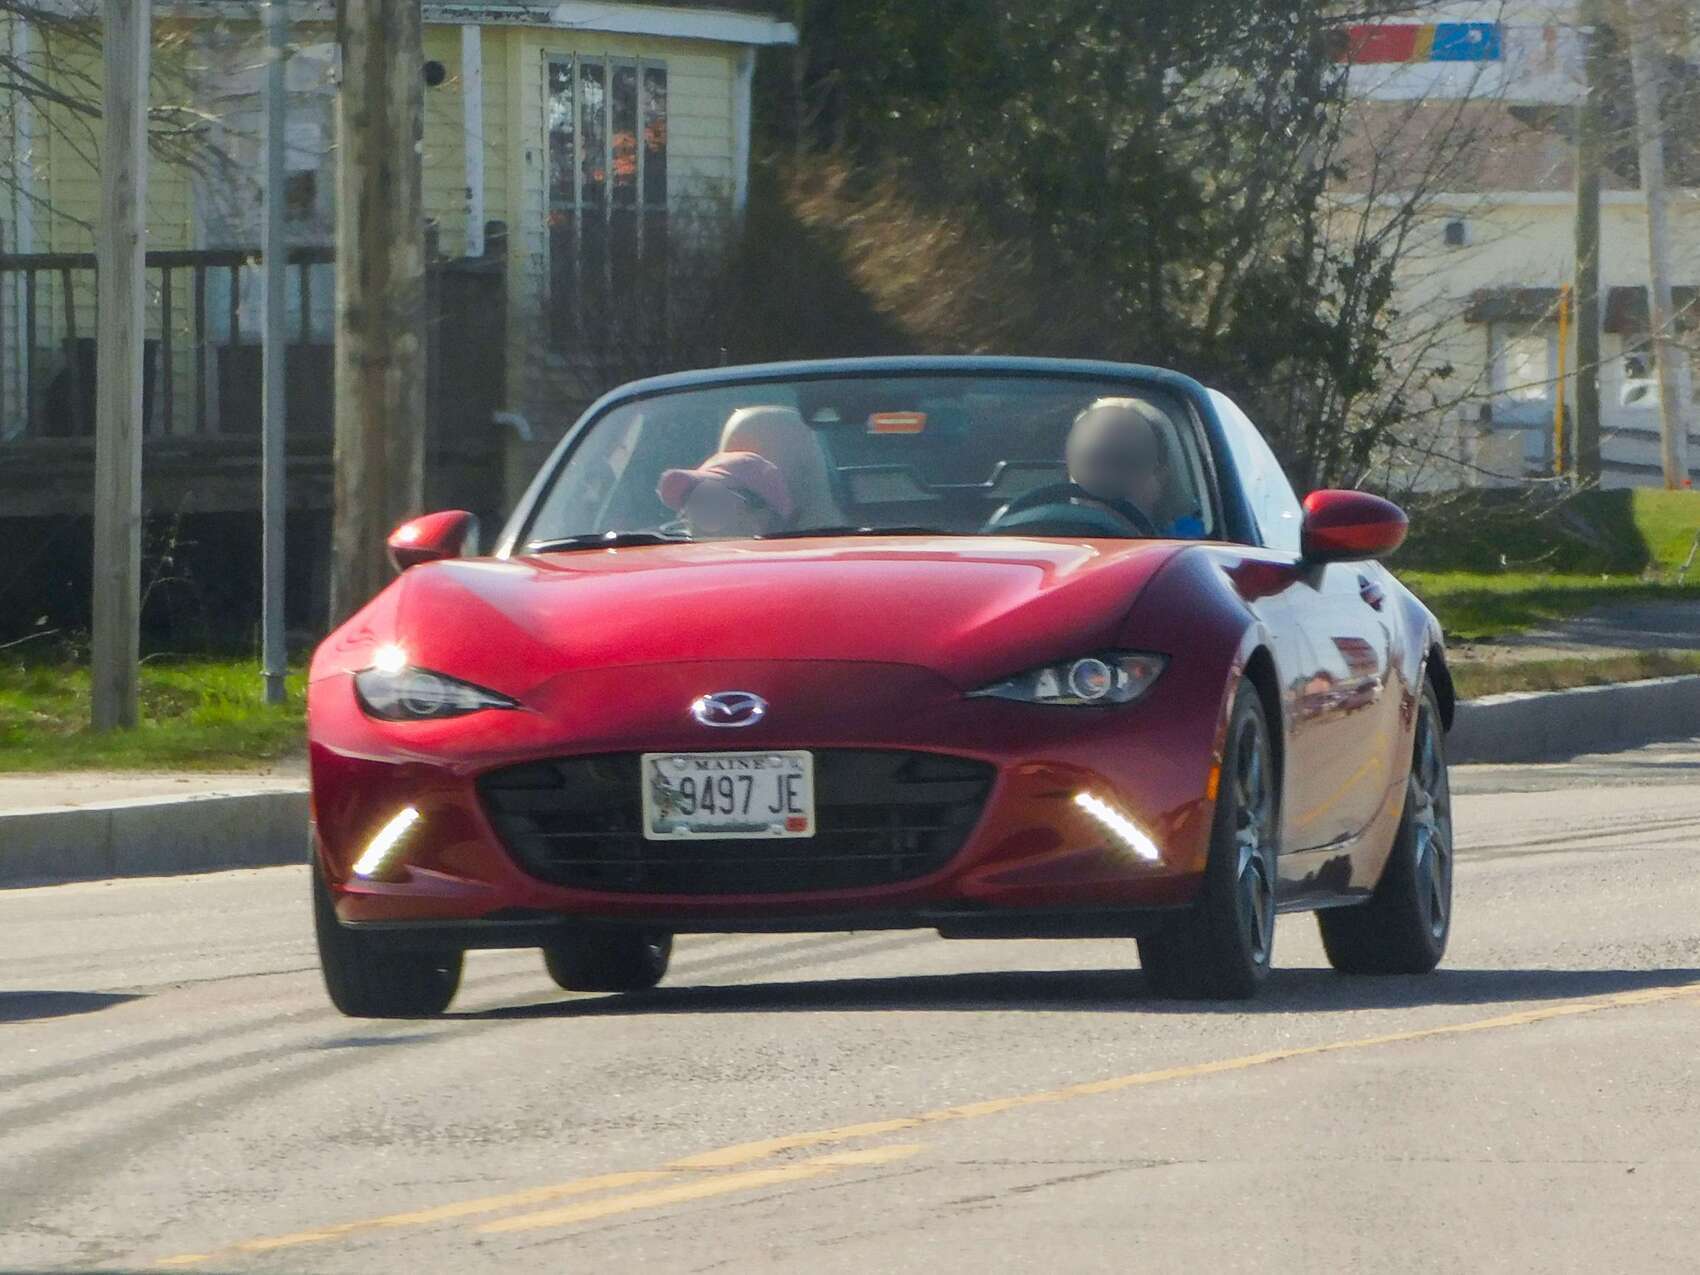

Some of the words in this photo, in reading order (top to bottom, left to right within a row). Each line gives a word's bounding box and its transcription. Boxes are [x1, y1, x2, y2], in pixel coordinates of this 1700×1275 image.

[695, 760, 766, 770] MAINE
[680, 775, 753, 815] 9497
[768, 774, 803, 814] JE
